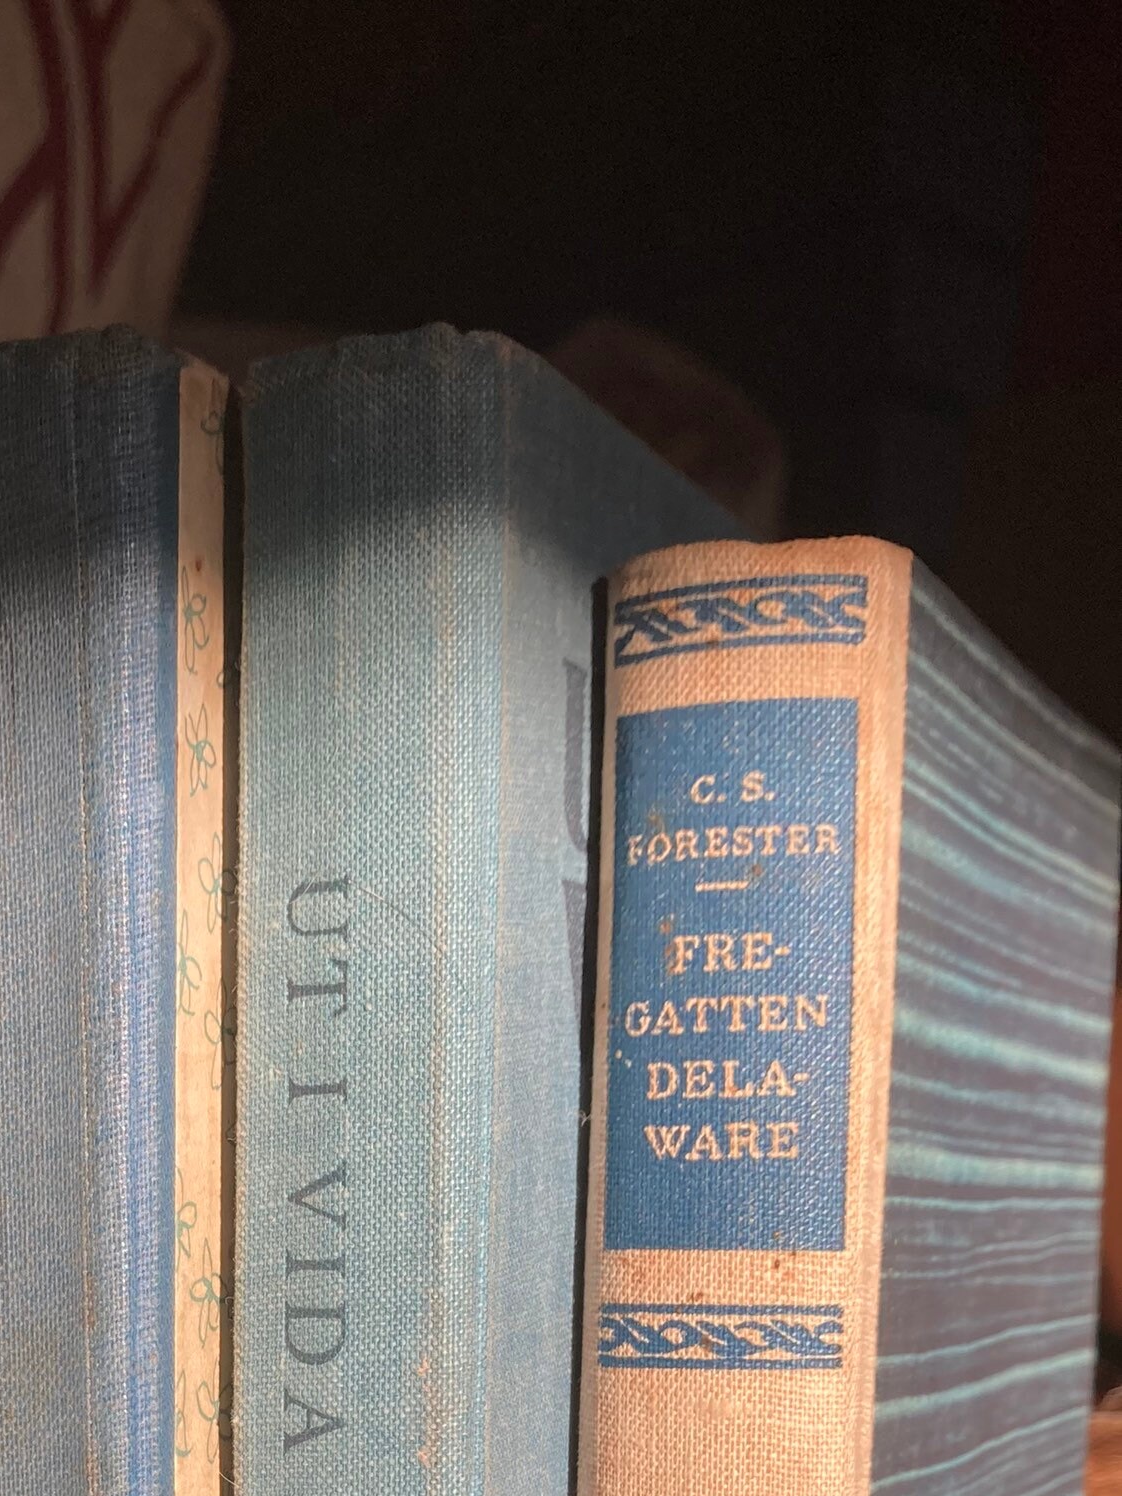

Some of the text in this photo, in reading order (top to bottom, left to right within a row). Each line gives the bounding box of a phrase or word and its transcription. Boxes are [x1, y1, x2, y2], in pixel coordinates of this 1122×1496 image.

[689, 770, 775, 804] C. S.
[626, 823, 841, 866] FORESTER
[285, 876, 349, 1016] UT
[670, 930, 792, 975] FRE-
[624, 993, 829, 1038] GATTEN
[287, 1078, 347, 1101] I
[646, 1059, 811, 1100] DELA-
[644, 1121, 800, 1162] WARE
[283, 1161, 347, 1453] VIDA
